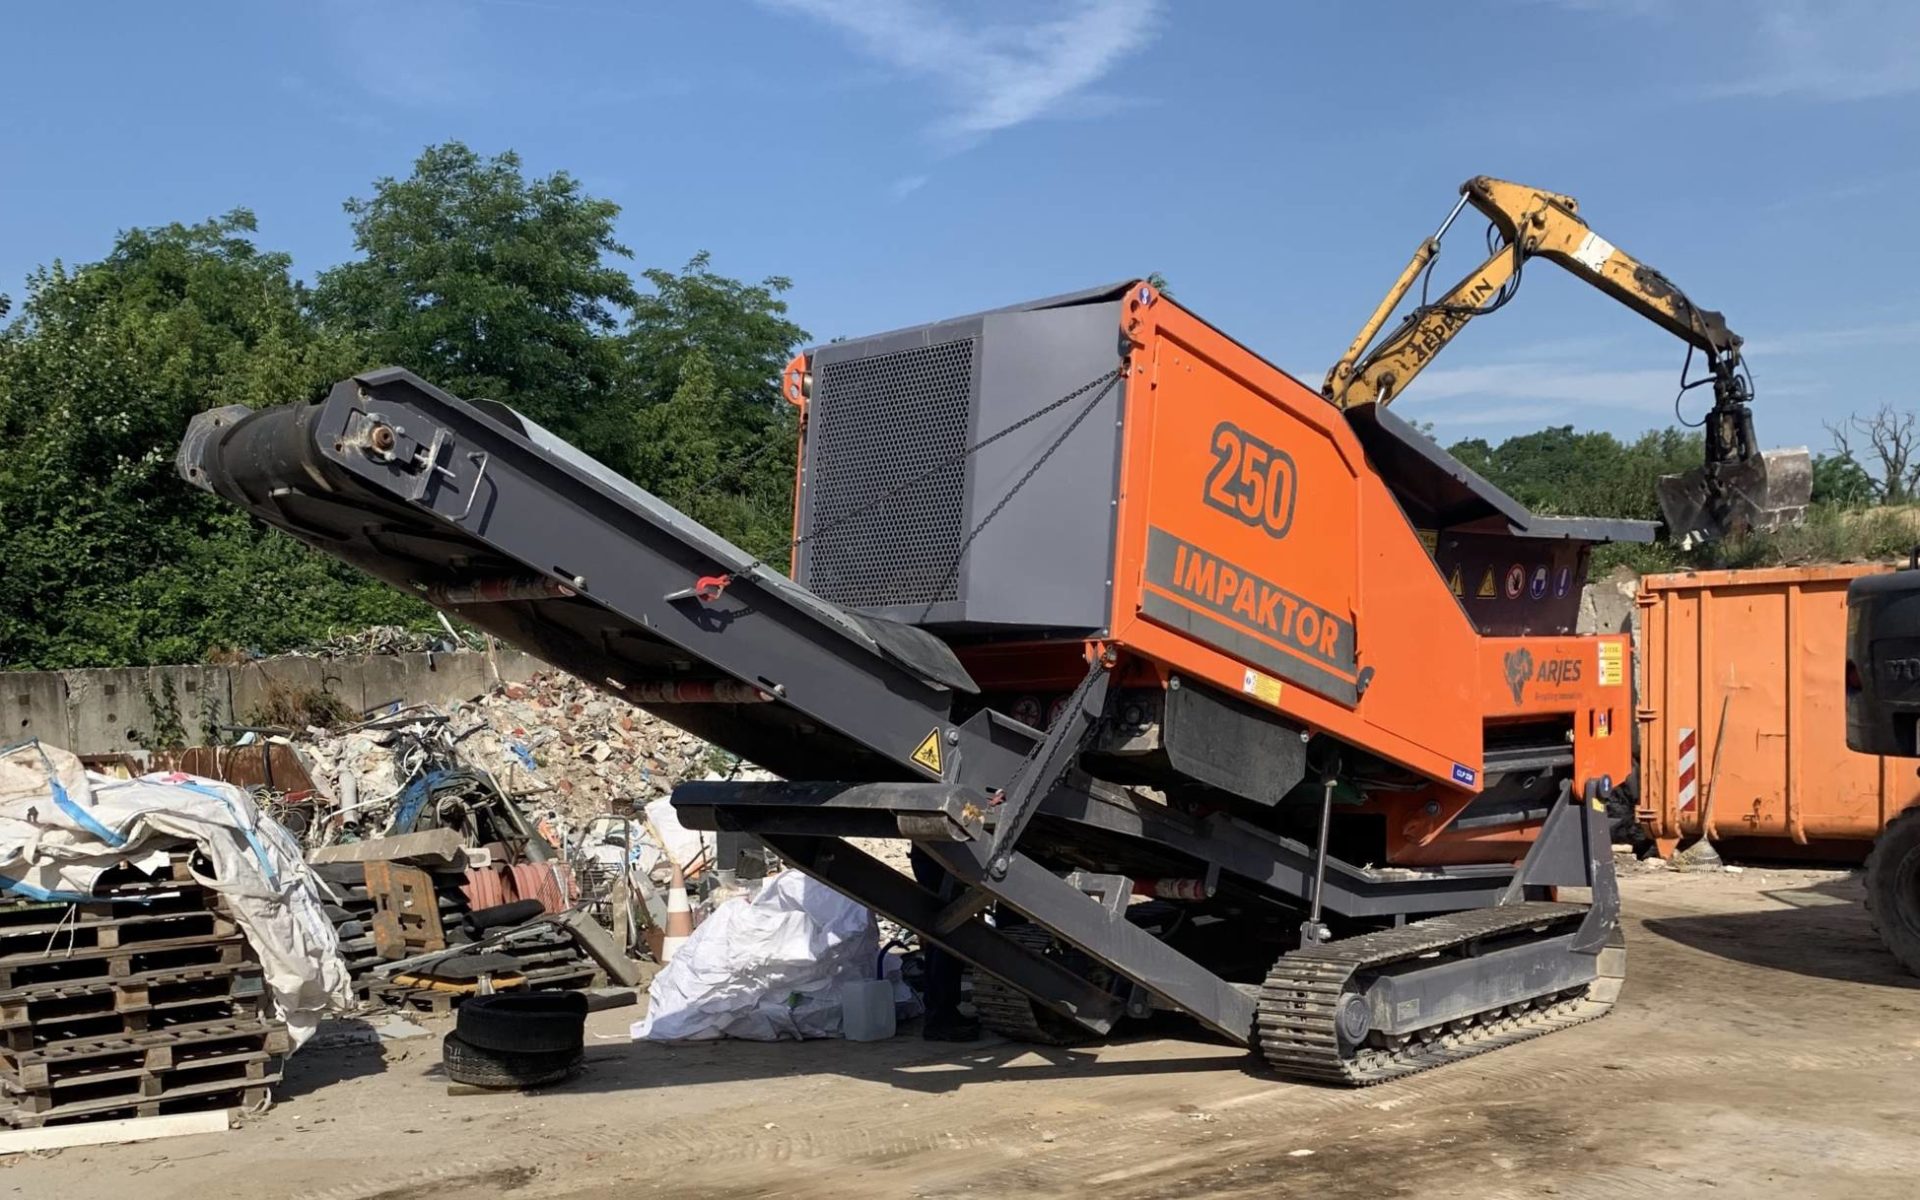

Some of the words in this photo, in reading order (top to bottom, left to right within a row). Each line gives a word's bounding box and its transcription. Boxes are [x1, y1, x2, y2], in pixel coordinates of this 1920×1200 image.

[1414, 277, 1494, 363] ZEPPIN
[1204, 422, 1297, 538] 250
[1173, 545, 1339, 658] IMPAKTOR
[1536, 659, 1582, 688] ARJES
